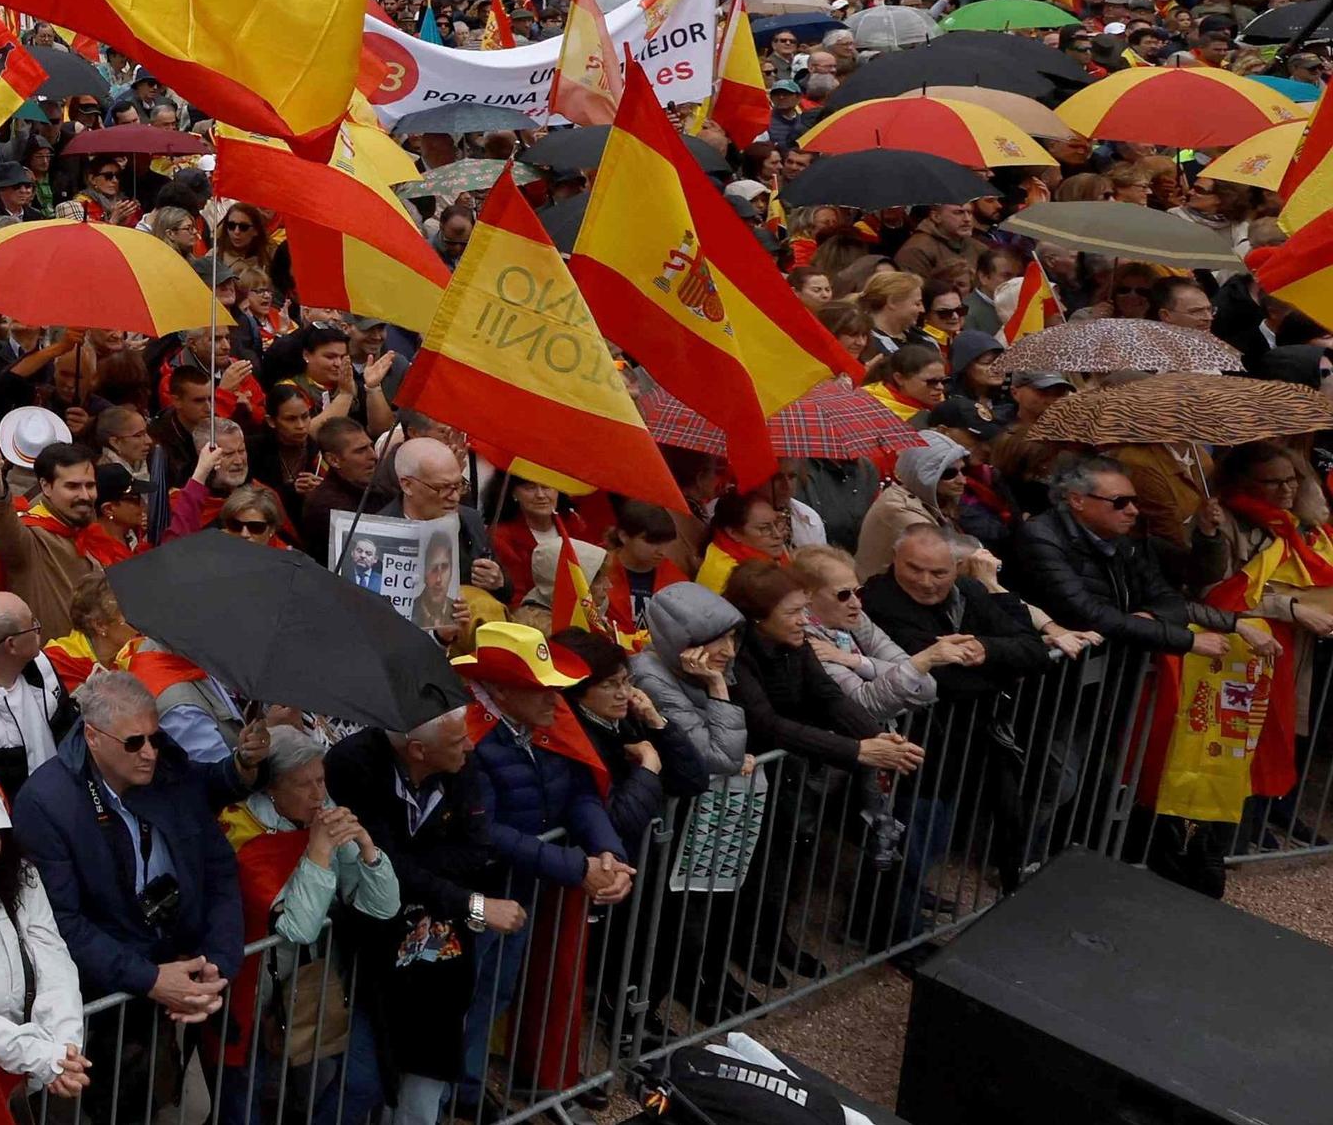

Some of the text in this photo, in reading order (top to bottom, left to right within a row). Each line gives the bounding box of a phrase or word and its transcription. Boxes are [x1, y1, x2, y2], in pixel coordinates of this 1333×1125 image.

[655, 61, 694, 85] es
[385, 557, 417, 572] Pedr
[384, 574, 398, 587] el
[87, 779, 104, 814] SONY
[717, 1063, 809, 1107] PUMA
